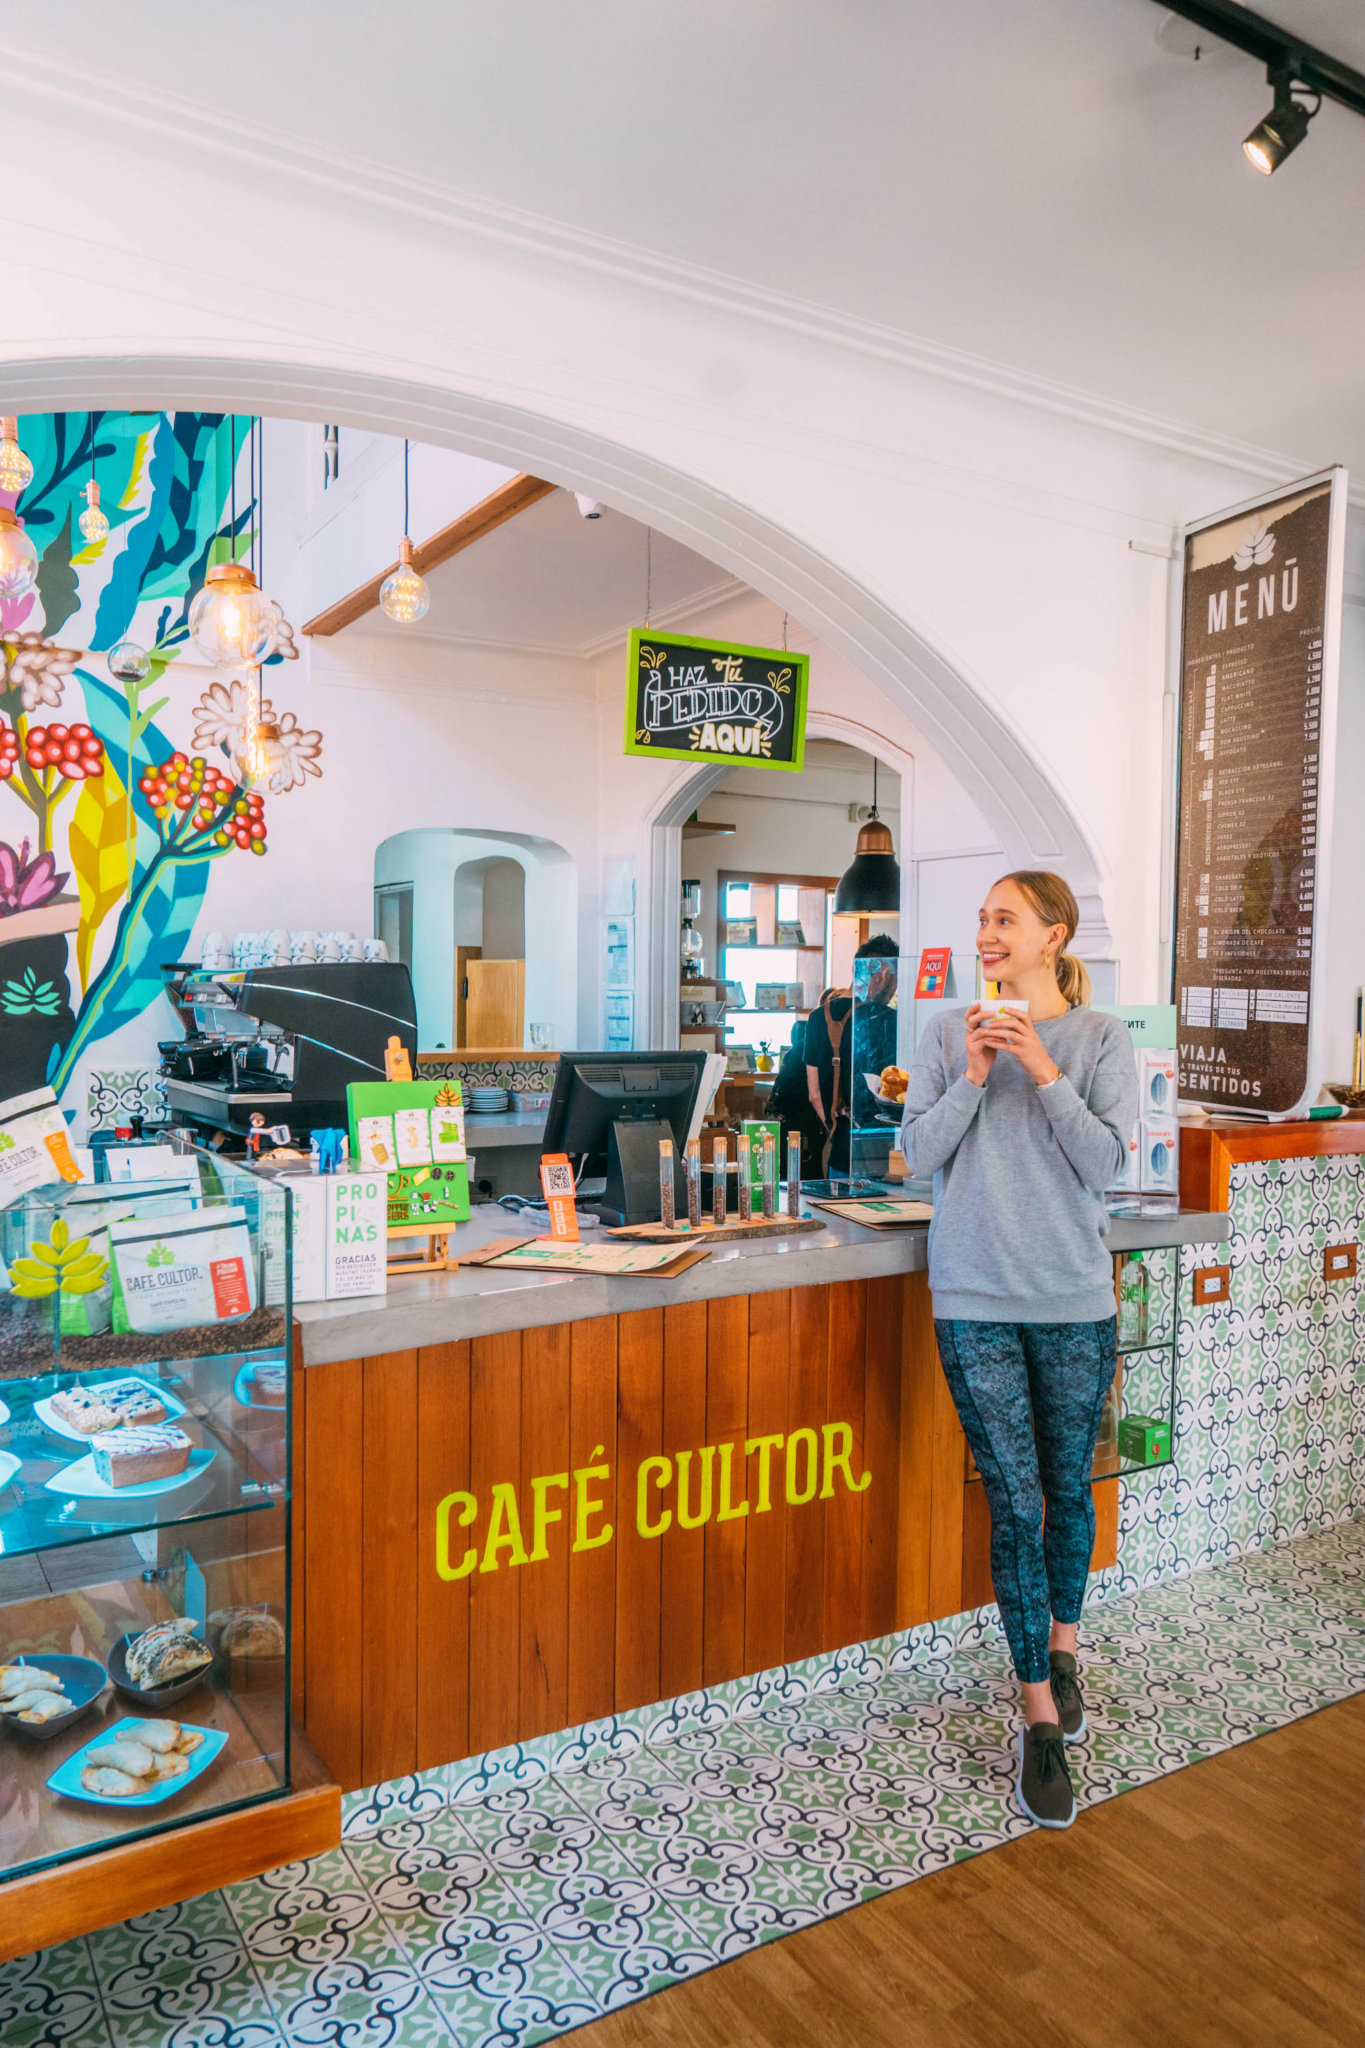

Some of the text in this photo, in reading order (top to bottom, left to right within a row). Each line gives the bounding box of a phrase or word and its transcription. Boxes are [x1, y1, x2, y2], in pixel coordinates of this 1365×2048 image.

[668, 666, 708, 687] HAZ
[649, 686, 762, 727] PEDIDO
[700, 721, 764, 754] AQUÍ
[1180, 1044, 1227, 1063] VIAJA
[1216, 1066, 1224, 1074] DE
[1228, 1067, 1241, 1075] TUS
[1179, 1072, 1262, 1097] SENTIDOS
[336, 1183, 378, 1201] PRO
[336, 1205, 355, 1223] PI
[336, 1225, 378, 1244] NAS
[336, 1254, 376, 1265] GRACIAS
[436, 1421, 872, 1581] CAFÉ CULTOR
